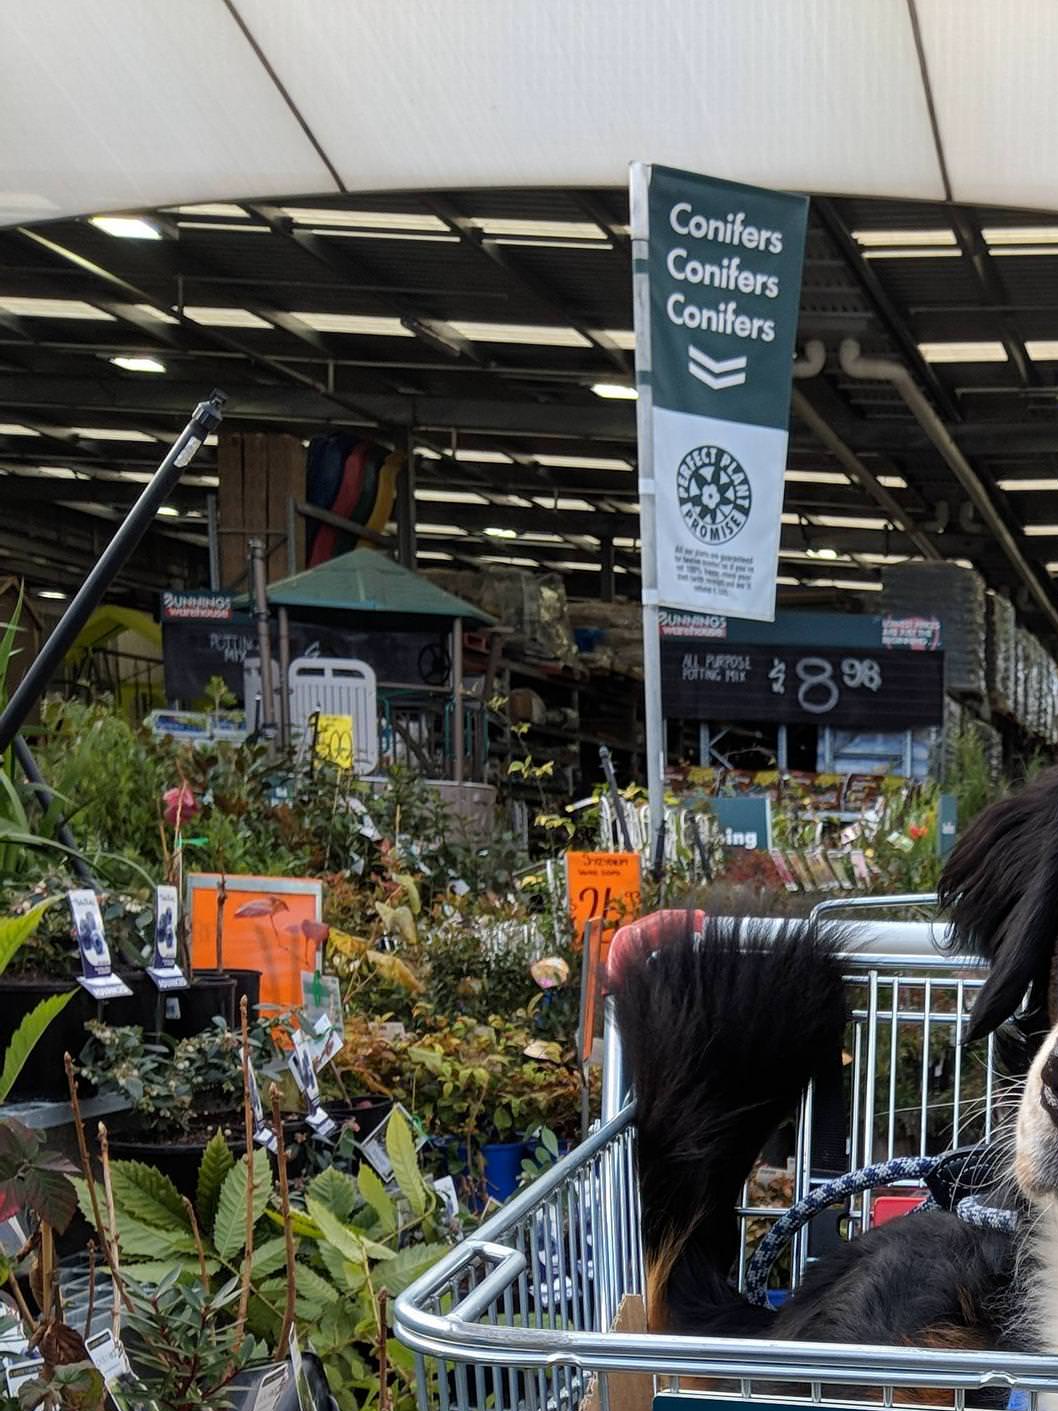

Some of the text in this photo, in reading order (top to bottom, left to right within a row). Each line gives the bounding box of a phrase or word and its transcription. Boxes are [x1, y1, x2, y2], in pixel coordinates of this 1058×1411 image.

[669, 202, 783, 254] Conifers
[666, 247, 780, 298] Conifers
[666, 292, 776, 342] Conifers
[678, 447, 751, 508] PERFECT PLANT
[683, 508, 743, 541] PROMISE
[163, 592, 231, 609] BUNNINGS
[167, 607, 229, 619] warehouse
[657, 611, 727, 629] BUNNINGS
[682, 653, 751, 670] ALL PURPOSE
[682, 668, 747, 682] POTTING MIX
[724, 828, 757, 850] ing
